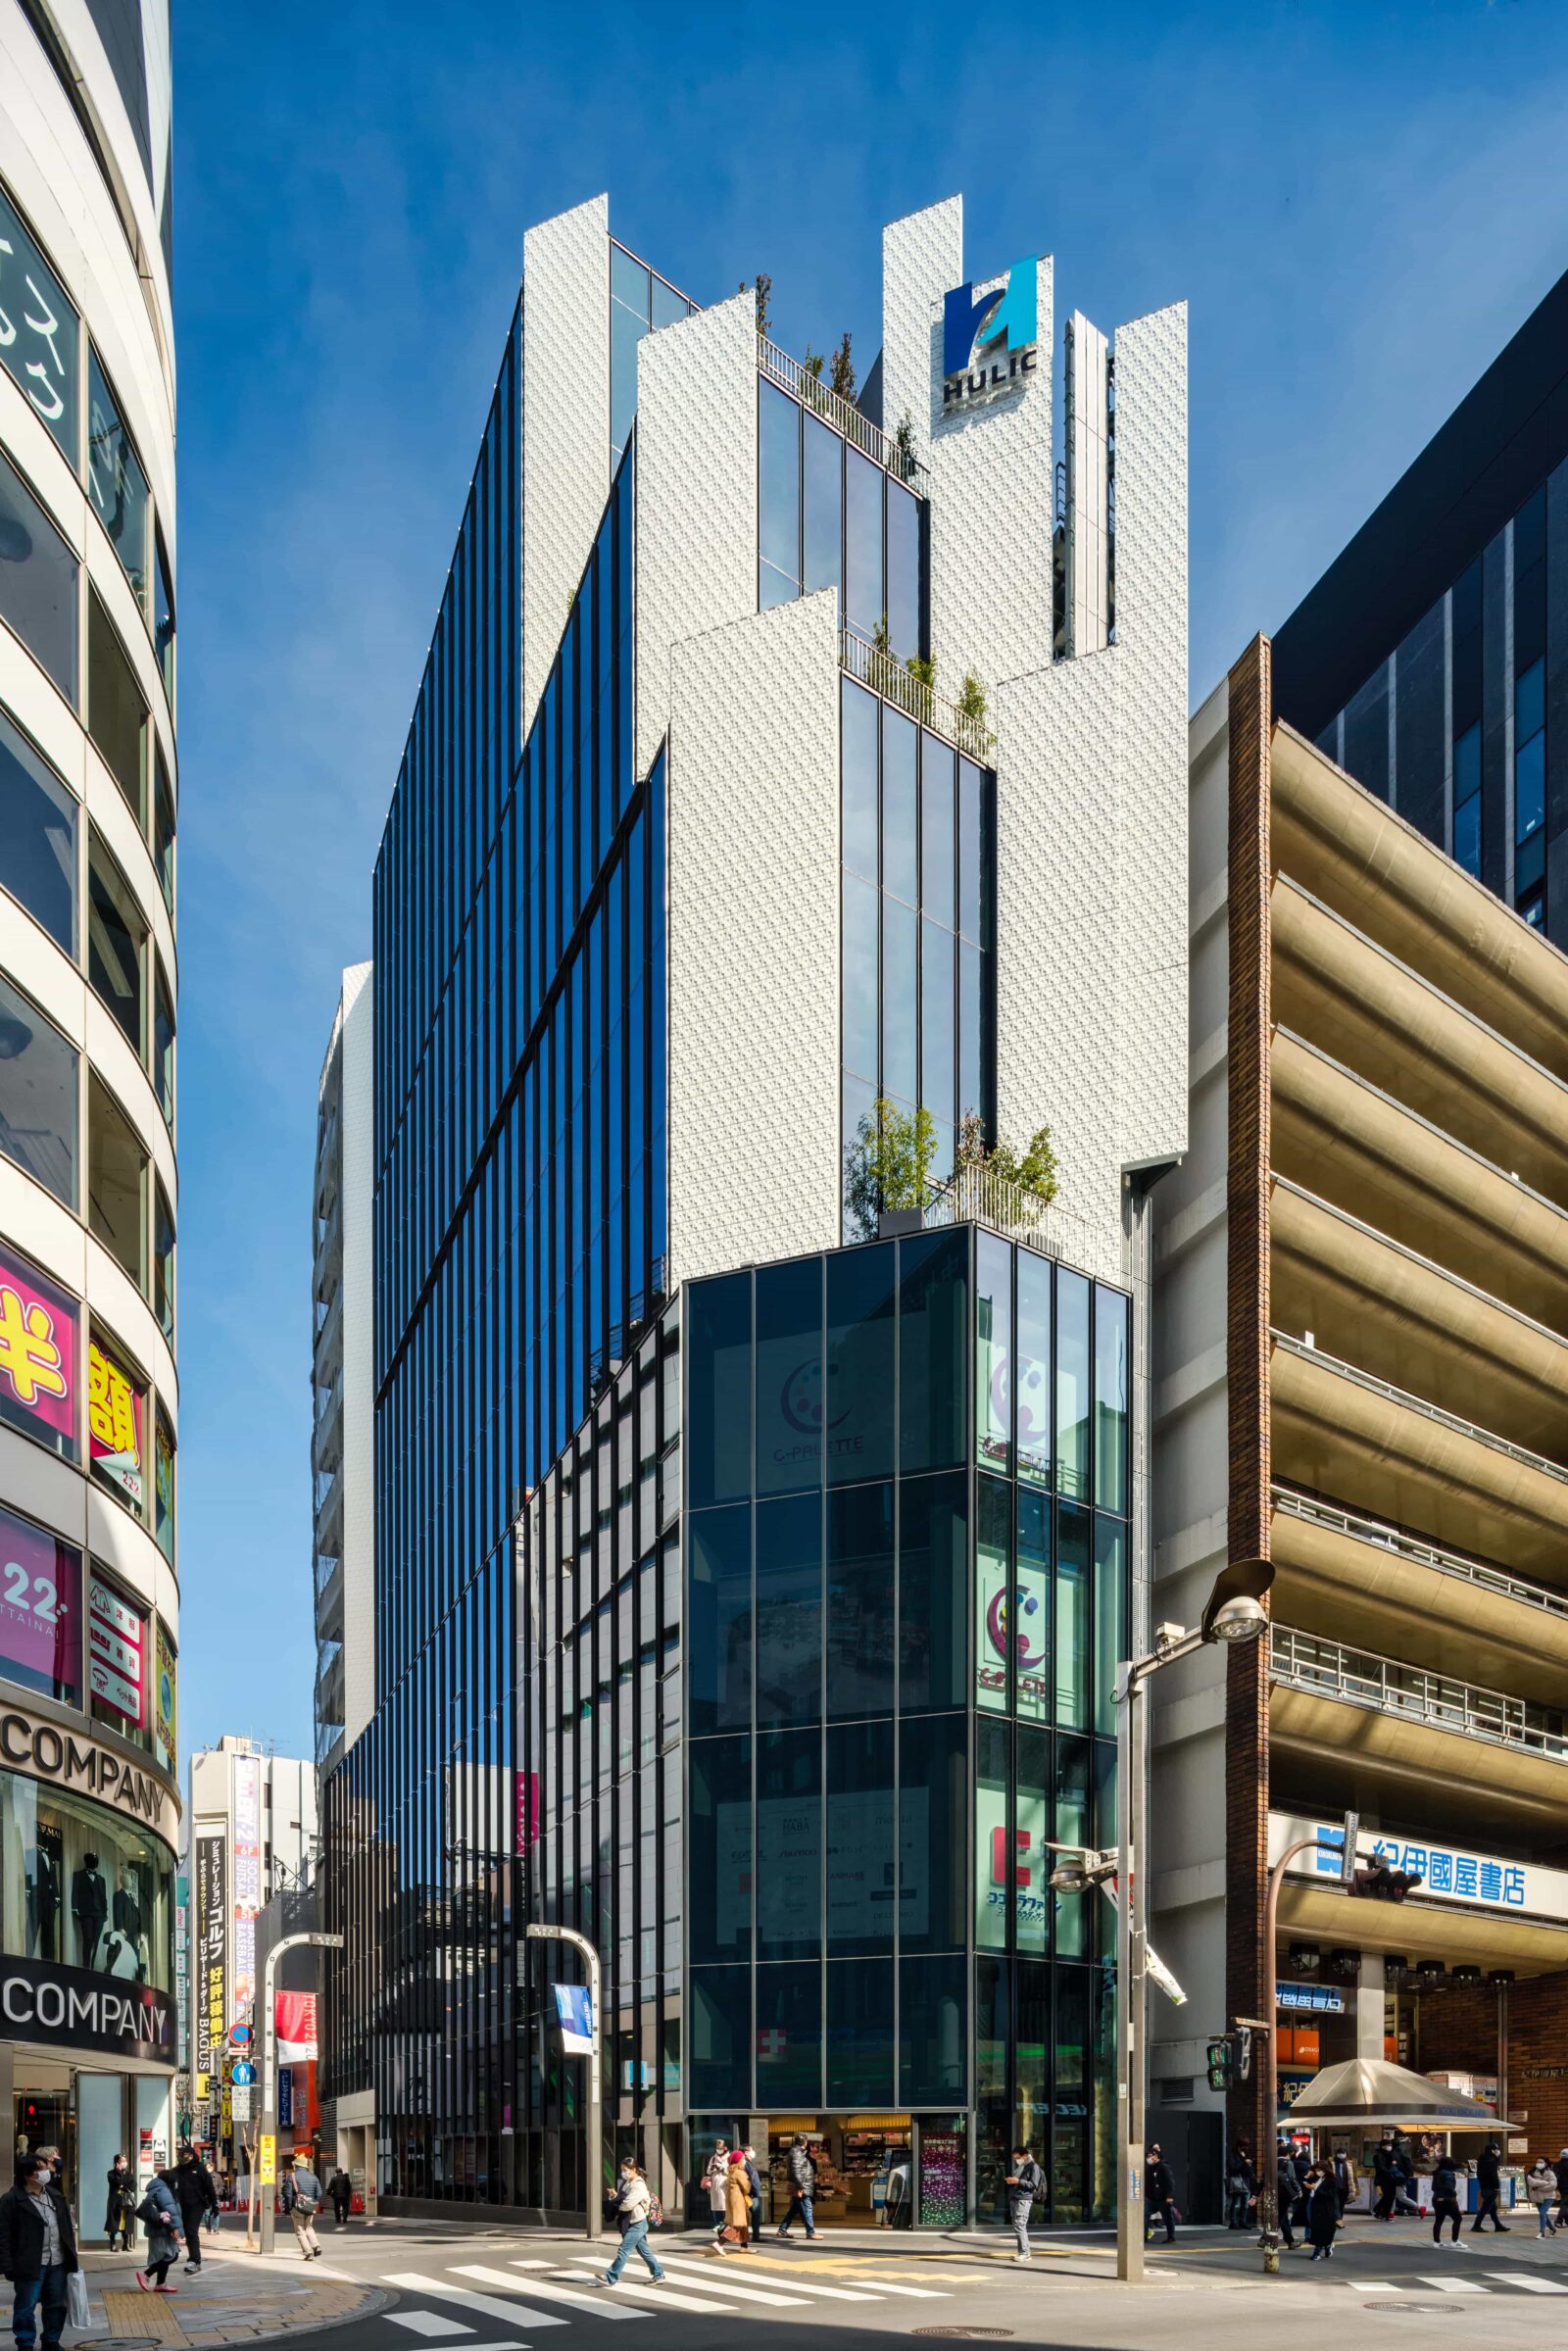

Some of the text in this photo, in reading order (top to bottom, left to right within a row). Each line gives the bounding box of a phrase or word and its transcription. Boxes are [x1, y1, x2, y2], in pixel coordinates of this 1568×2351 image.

[944, 350, 1037, 404] HULIC
[0, 1714, 165, 1824] COMPANY
[783, 1822, 809, 1832] HABA
[1373, 1839, 1525, 1905] 紀伊國屋書店
[3, 1977, 167, 2044] COMPANY
[199, 2018, 210, 2070] BAGUS
